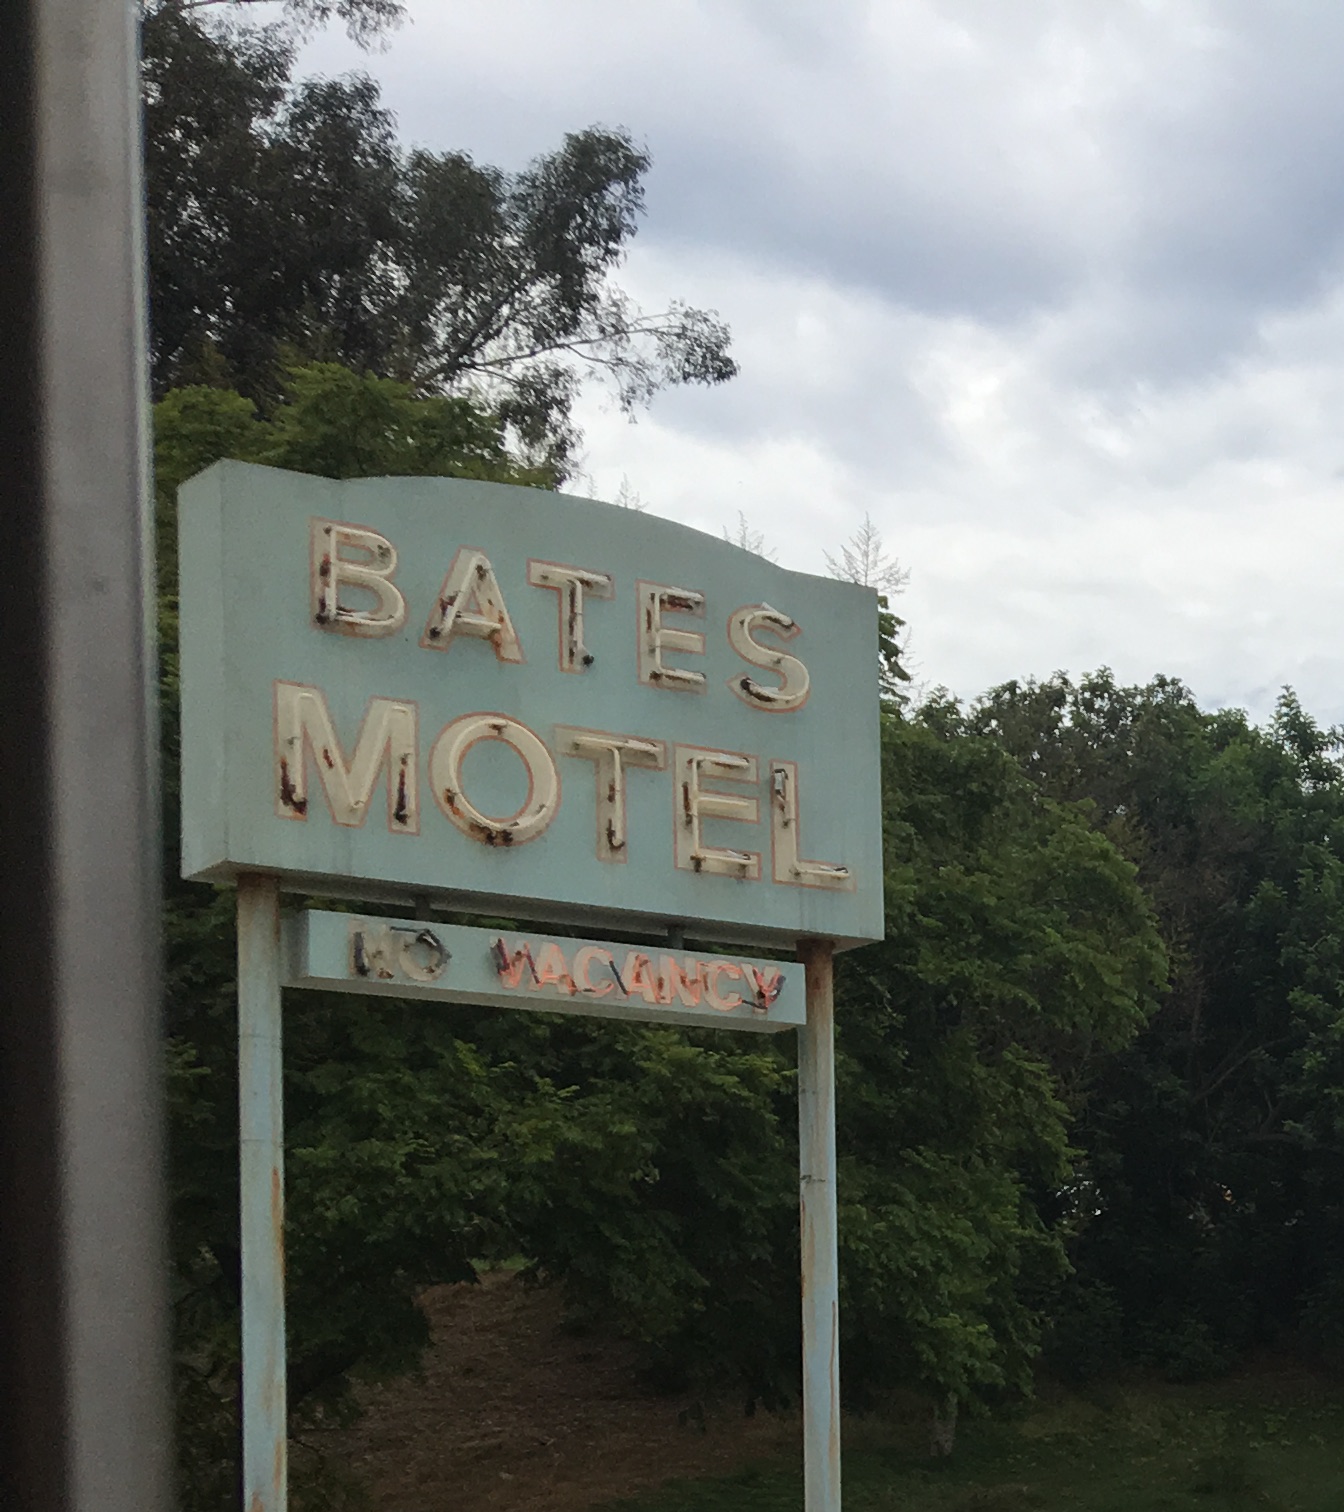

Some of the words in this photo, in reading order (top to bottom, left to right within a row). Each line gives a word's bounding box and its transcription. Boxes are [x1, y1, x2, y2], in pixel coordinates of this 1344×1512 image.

[311, 516, 810, 713] BATES
[273, 680, 856, 892] MOTEL
[348, 918, 452, 982] NO
[491, 937, 786, 1015] VACANCY
